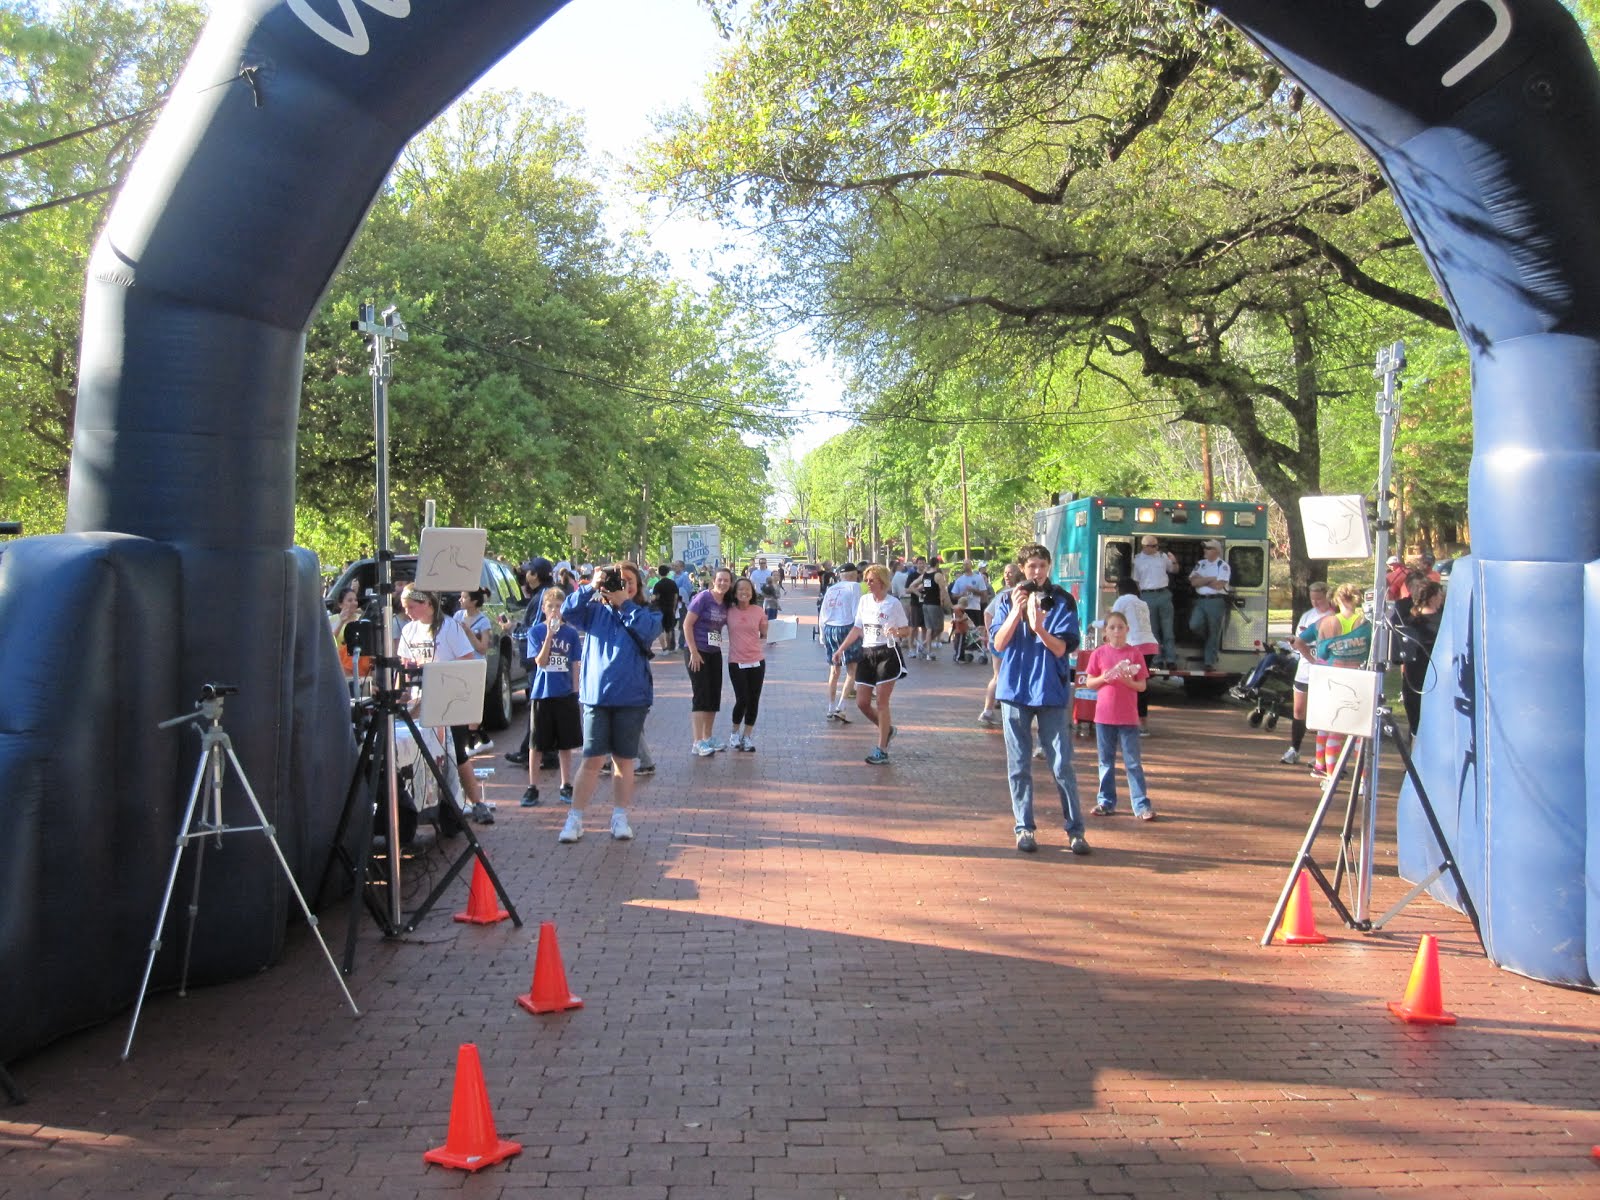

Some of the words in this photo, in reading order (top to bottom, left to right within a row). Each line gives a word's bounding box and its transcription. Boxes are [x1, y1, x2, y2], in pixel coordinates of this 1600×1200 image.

[687, 538, 705, 551] Oak
[683, 545, 710, 561] Farms
[541, 638, 571, 653] XAS
[547, 656, 569, 666] 984
